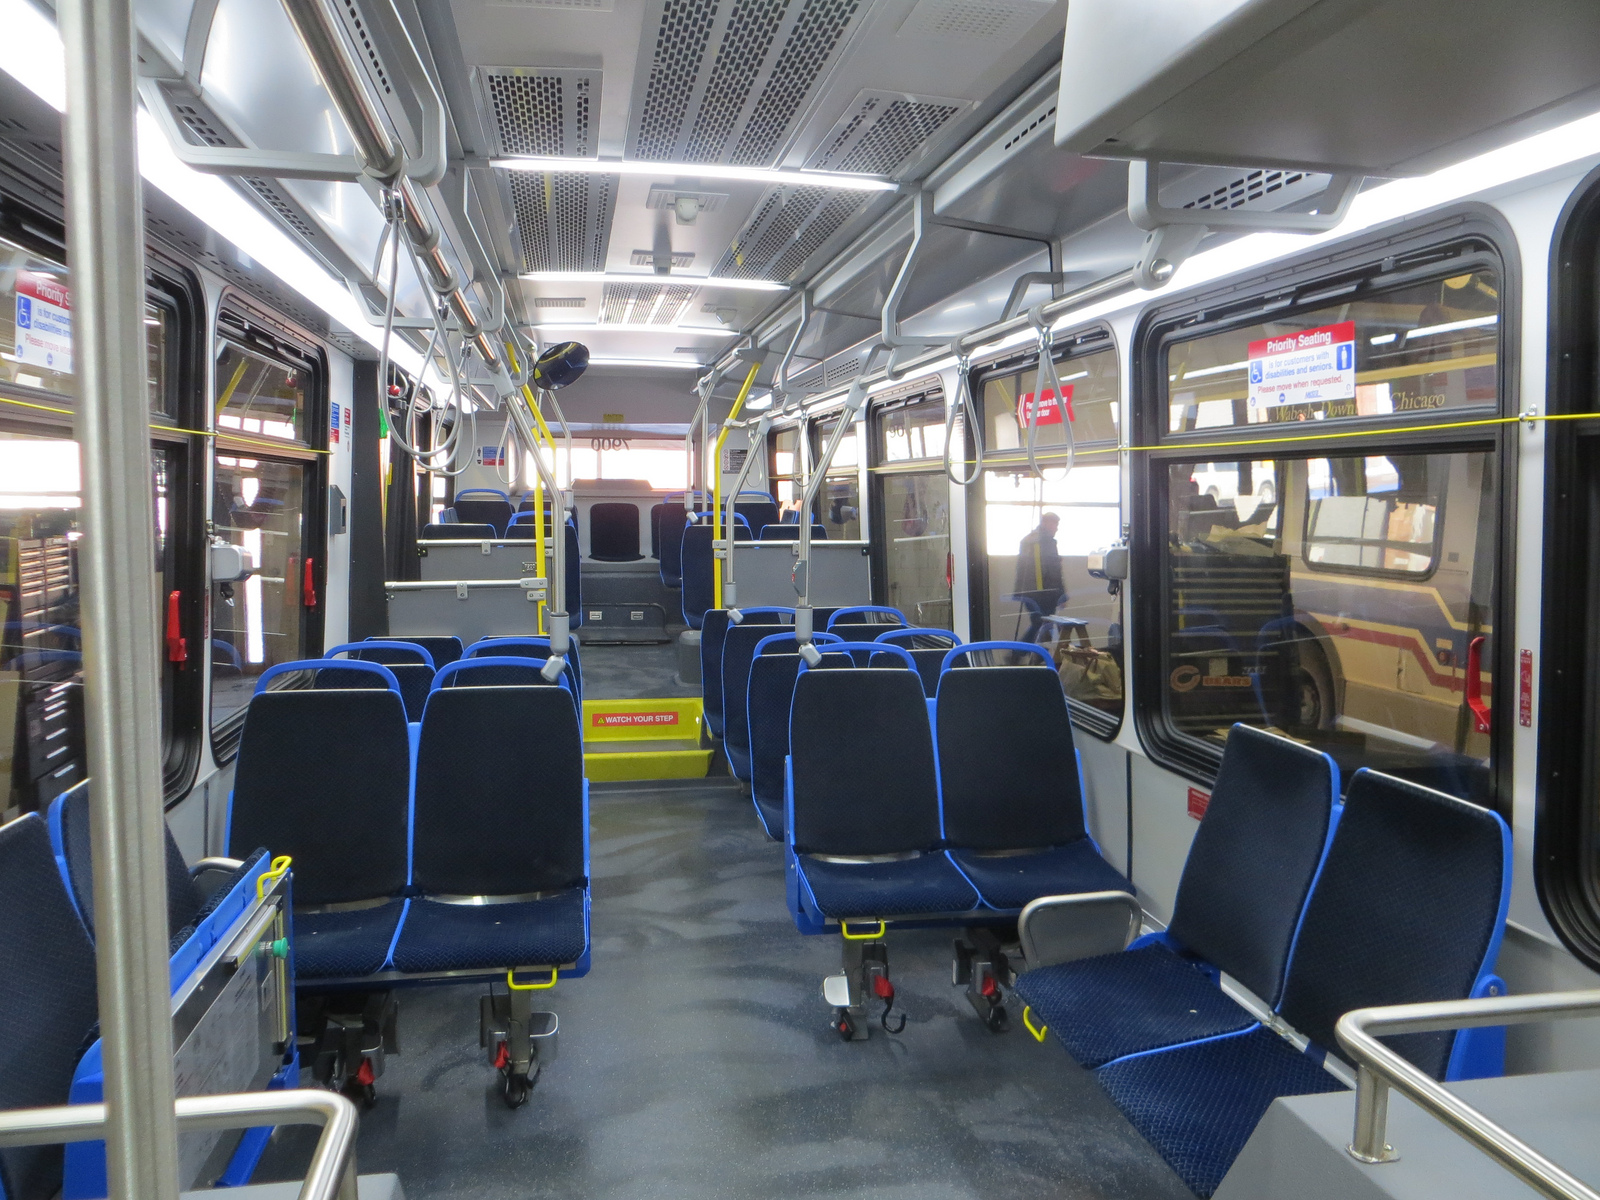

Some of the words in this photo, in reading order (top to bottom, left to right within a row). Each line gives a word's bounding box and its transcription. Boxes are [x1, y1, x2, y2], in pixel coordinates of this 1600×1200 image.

[36, 280, 64, 306] Priority
[1266, 337, 1297, 353] Priority
[1298, 330, 1332, 348] Seating
[1268, 360, 1274, 369] is
[1274, 359, 1282, 368] for
[1283, 355, 1316, 366] customers
[1317, 351, 1330, 361] with
[1265, 367, 1295, 380] disabilities
[1296, 364, 1308, 375] and
[1308, 362, 1334, 374] seniors.
[1257, 383, 1276, 394] Please
[1276, 382, 1293, 391] move
[1292, 379, 1309, 389] when
[1309, 374, 1344, 388] requested.
[633, 715, 654, 723] YOUR
[655, 714, 674, 722] STEP
